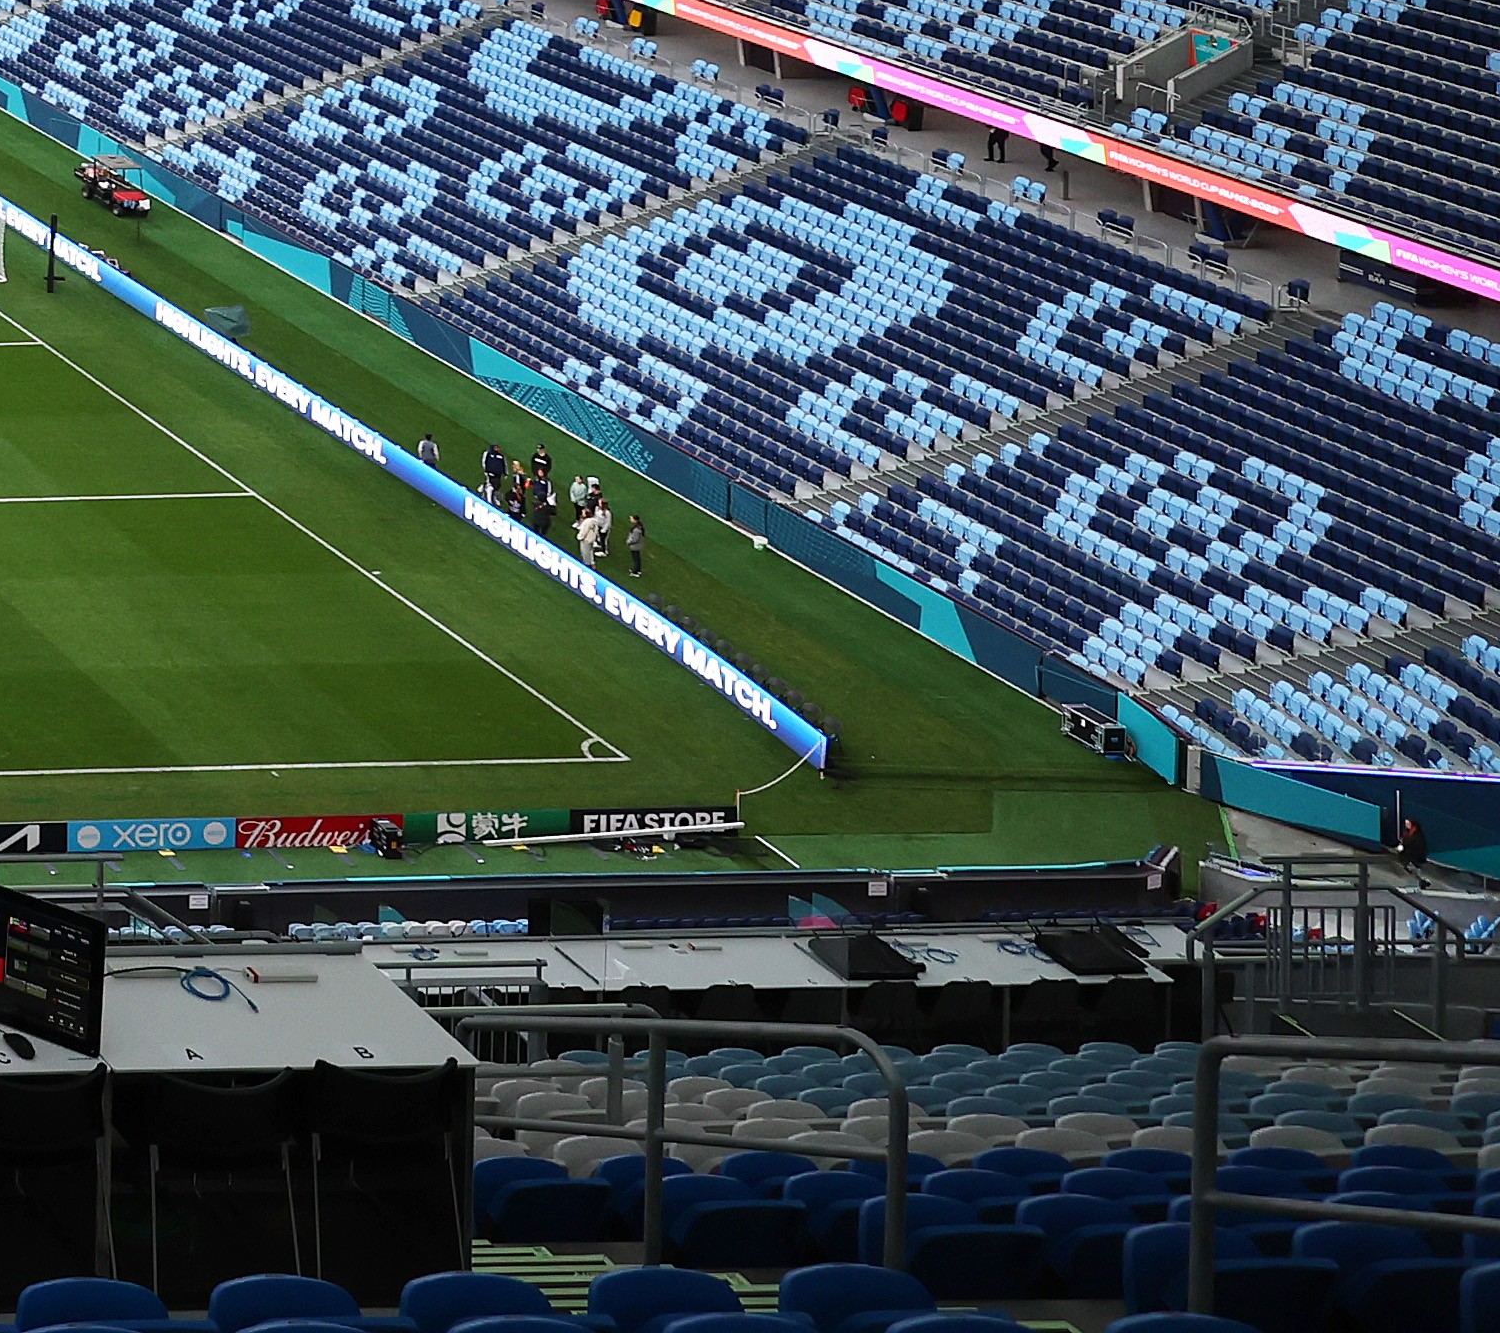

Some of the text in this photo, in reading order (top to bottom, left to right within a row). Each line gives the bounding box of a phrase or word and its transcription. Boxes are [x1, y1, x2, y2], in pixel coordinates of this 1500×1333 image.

[1109, 149, 1130, 166] FIFA
[1168, 170, 1200, 189] WORLD
[7, 205, 52, 250] EVERY
[155, 300, 388, 465] HIGHLIGHTS. EVERY MATCH.
[463, 495, 779, 730] HIGHLIGHTS. EVERY MATCH.
[113, 821, 191, 846] xero
[471, 811, 529, 839] 蒙牛
[185, 1048, 204, 1060] A
[353, 1047, 374, 1059] B
